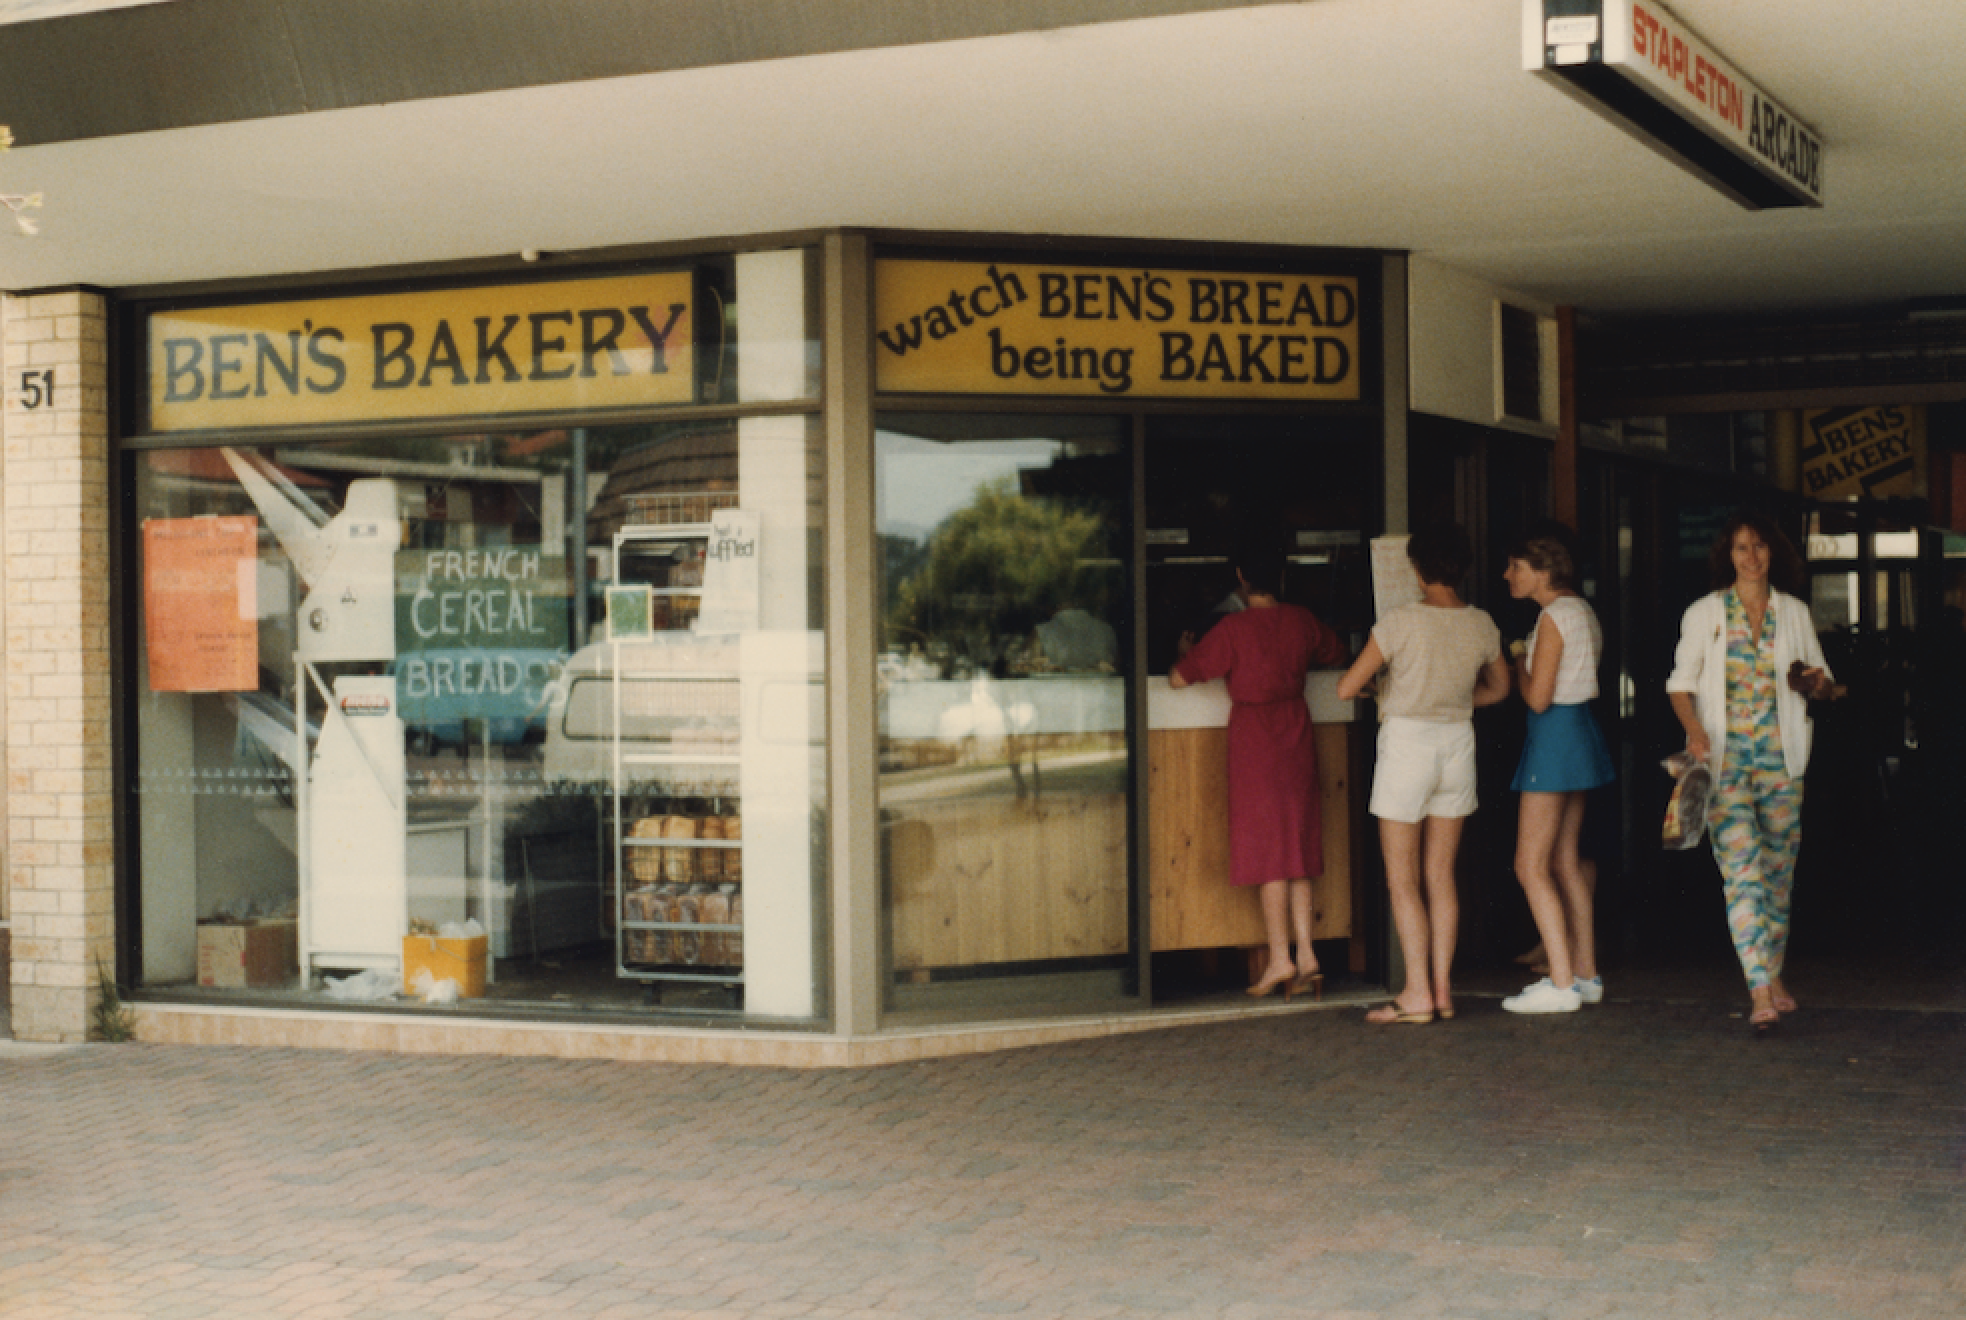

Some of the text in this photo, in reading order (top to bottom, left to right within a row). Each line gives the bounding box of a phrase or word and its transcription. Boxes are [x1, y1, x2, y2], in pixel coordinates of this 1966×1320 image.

[1633, 3, 1820, 194] STAPLETON ARCADE
[876, 265, 1357, 357] watch BEN'S BREAD
[162, 303, 687, 403] BEN'S BAKERY
[988, 327, 1351, 393] being BAKED
[20, 369, 54, 410] 51
[1805, 427, 1911, 493] BAKERY
[426, 551, 539, 582] FRENCH
[410, 588, 546, 638] CEREAL
